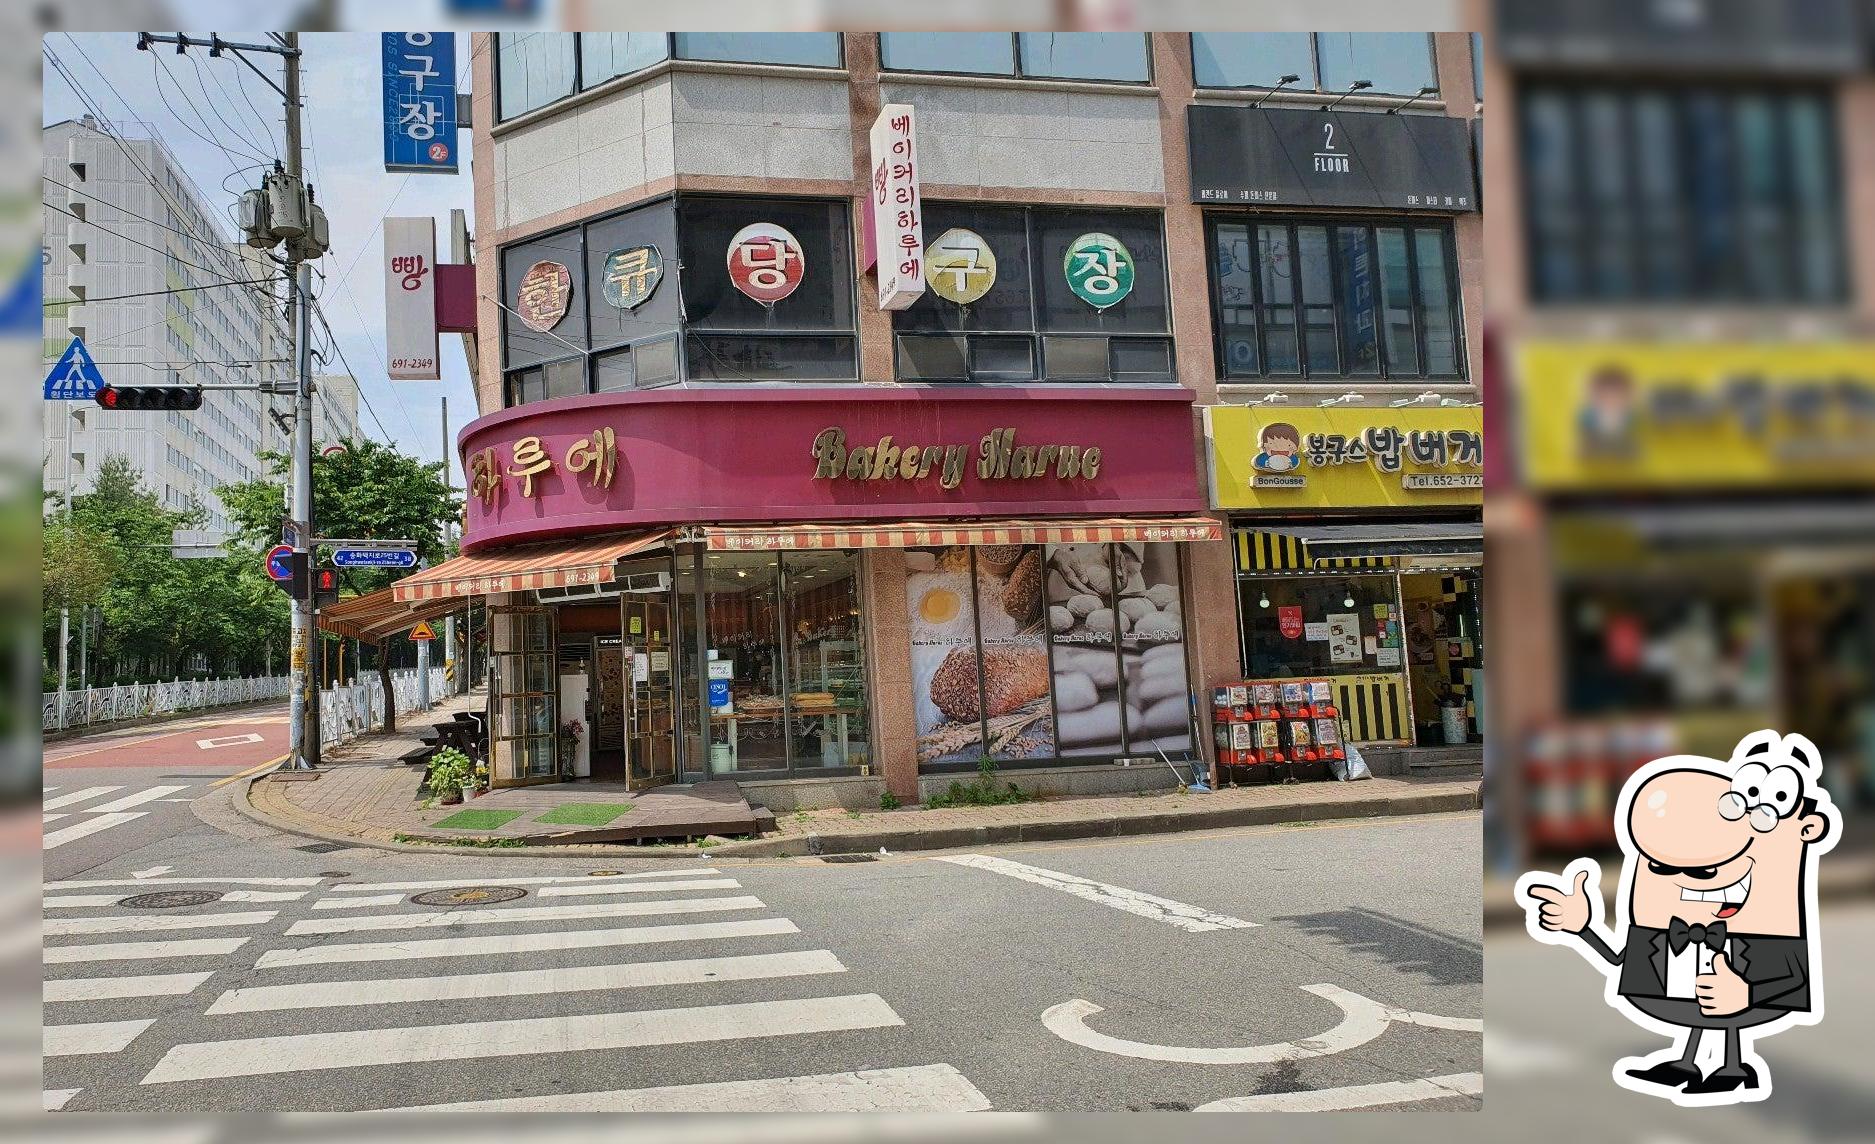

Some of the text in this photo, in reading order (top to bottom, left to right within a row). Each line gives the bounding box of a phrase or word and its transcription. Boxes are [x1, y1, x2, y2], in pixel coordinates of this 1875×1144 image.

[1324, 123, 1335, 150] 2
[432, 146, 446, 160] 2F
[1314, 157, 1350, 172] FLOOR
[874, 158, 889, 205] 빵
[391, 254, 429, 291] 빵
[392, 358, 433, 369] 691-2349
[810, 426, 970, 490] Bakery
[1308, 427, 1483, 472] 봉구스 밥버거
[471, 426, 616, 506] 하루에
[1257, 477, 1304, 486] BonGousse
[1410, 475, 1483, 486] Tel.652-372
